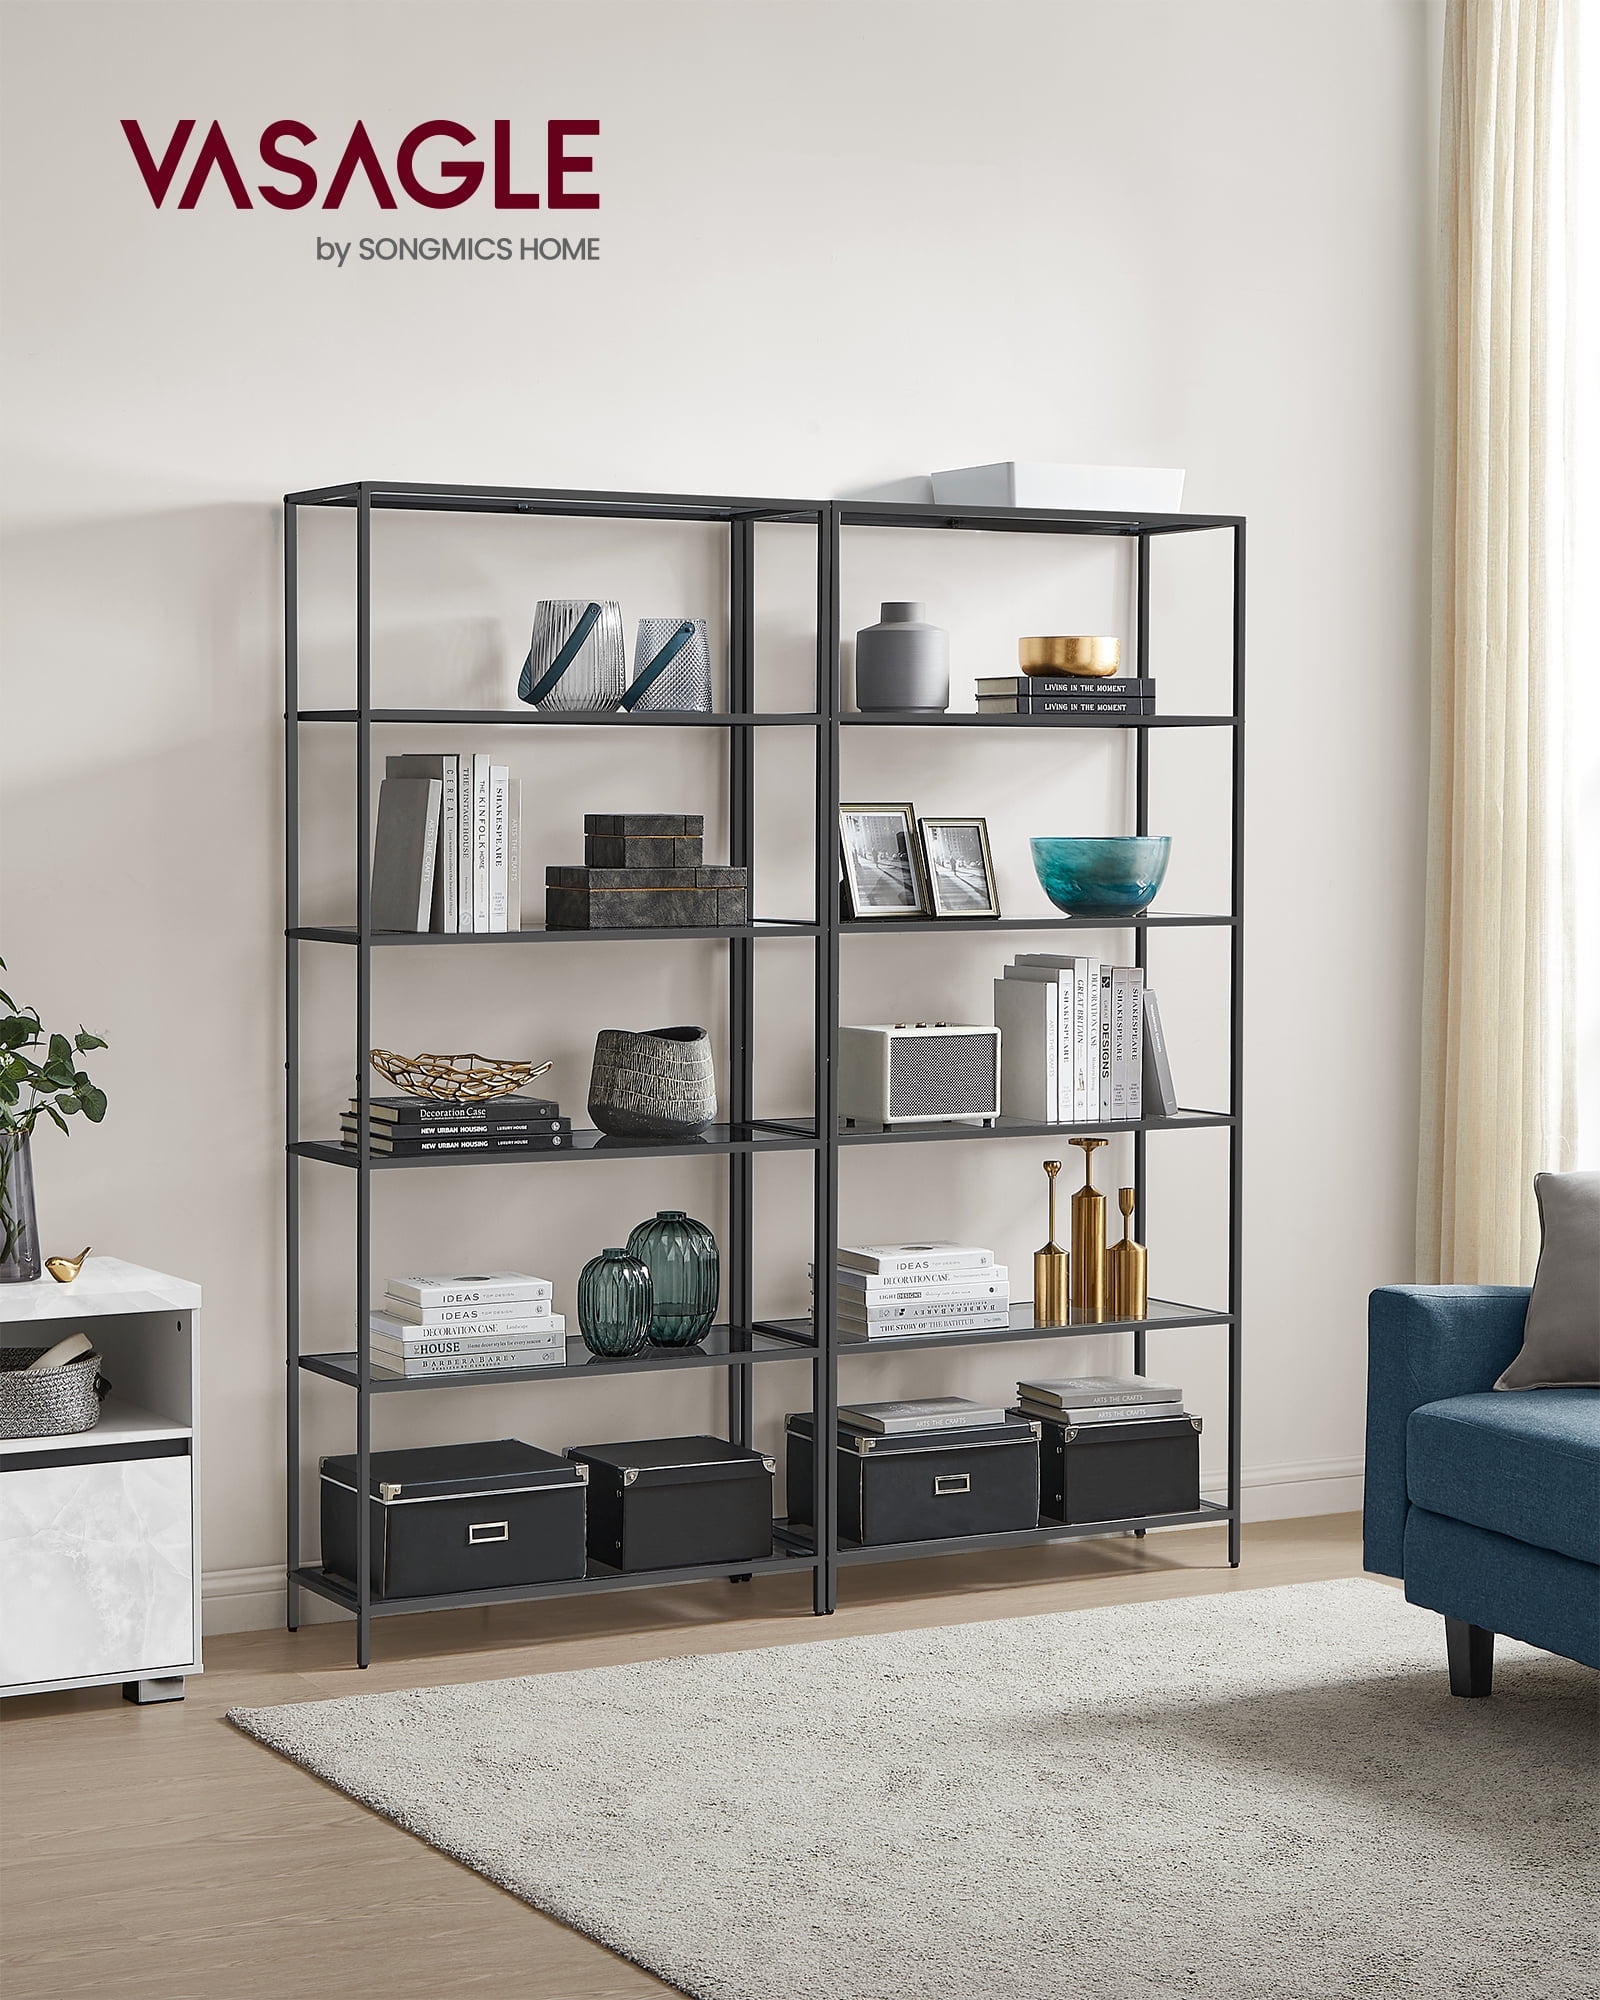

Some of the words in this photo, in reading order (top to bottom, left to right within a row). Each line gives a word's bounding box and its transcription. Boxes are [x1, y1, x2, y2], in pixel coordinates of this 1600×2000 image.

[1044, 683, 1068, 692] LIVING
[1070, 684, 1078, 692] IN
[1080, 684, 1095, 692] THE
[1097, 684, 1126, 693] MOMENT
[1044, 703, 1068, 711] LIVING
[1070, 703, 1078, 711] IN
[1080, 703, 1095, 711] THE
[1097, 704, 1127, 712] MOMENT
[462, 768, 470, 786] THE
[446, 769, 454, 821] CEREAL
[462, 788, 470, 827] VINTAGE
[478, 797, 486, 849] KINFOLK
[495, 787, 504, 868] SHAKESPEARE
[462, 828, 470, 859] HOUSE
[1090, 973, 1098, 1028] DECORATION
[1131, 988, 1139, 1061] SHAKESPEARE
[1102, 1023, 1110, 1079] DESIGNS
[420, 1108, 465, 1117] Decoration
[466, 1107, 486, 1116] Case
[437, 1126, 458, 1134] URBAN
[460, 1125, 487, 1133] HOUSING
[896, 1261, 929, 1270] IDEAS
[883, 1276, 931, 1286] DECORATION
[931, 1274, 950, 1283] CASE
[443, 1293, 480, 1303] IDEAS
[441, 1310, 478, 1320] IDEAS
[423, 1325, 477, 1337] DECORATION
[477, 1323, 499, 1333] CASE
[895, 1323, 917, 1331] STORY
[928, 1321, 943, 1329] THE
[420, 1342, 461, 1354] HOUSE
